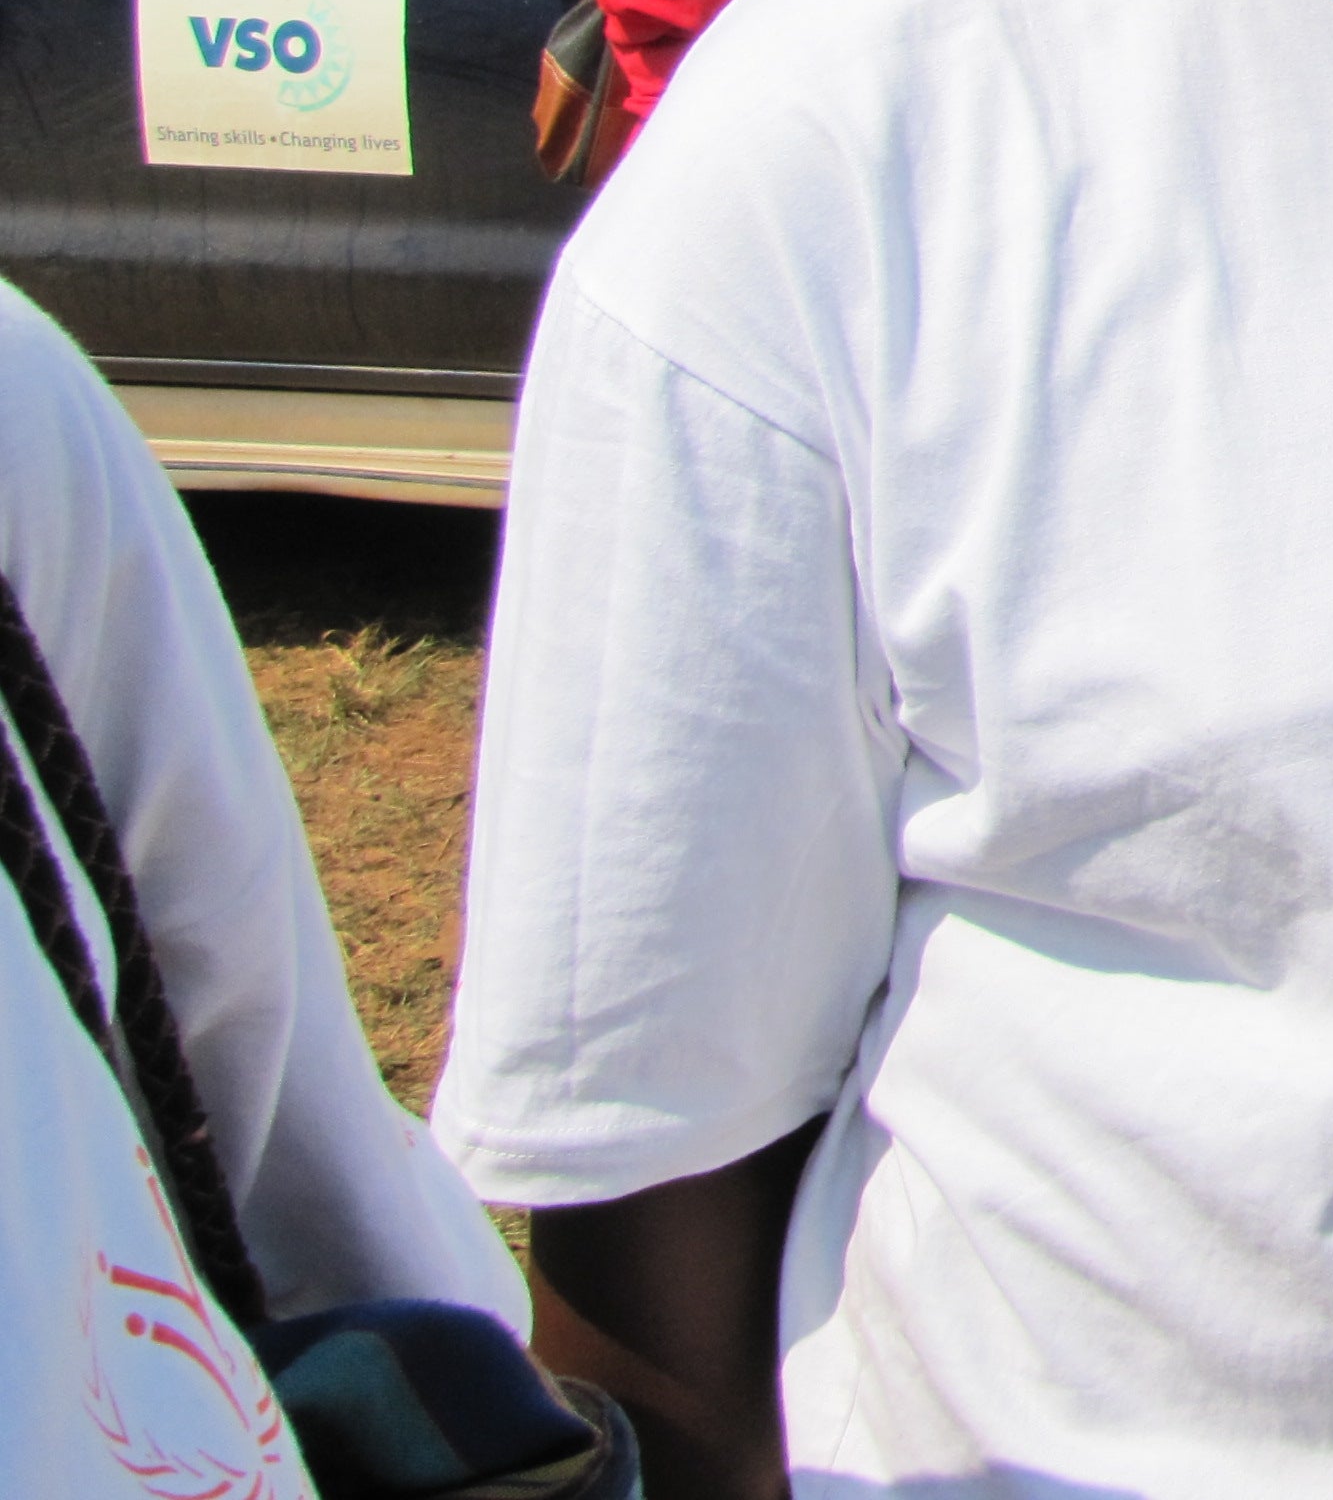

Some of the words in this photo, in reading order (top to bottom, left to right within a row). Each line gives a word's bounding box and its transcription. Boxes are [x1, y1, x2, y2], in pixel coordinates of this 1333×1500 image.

[188, 16, 322, 74] VSO
[157, 126, 219, 147] Sharing
[224, 130, 266, 146] skills
[279, 131, 357, 153] Changing
[363, 134, 401, 151] lives
